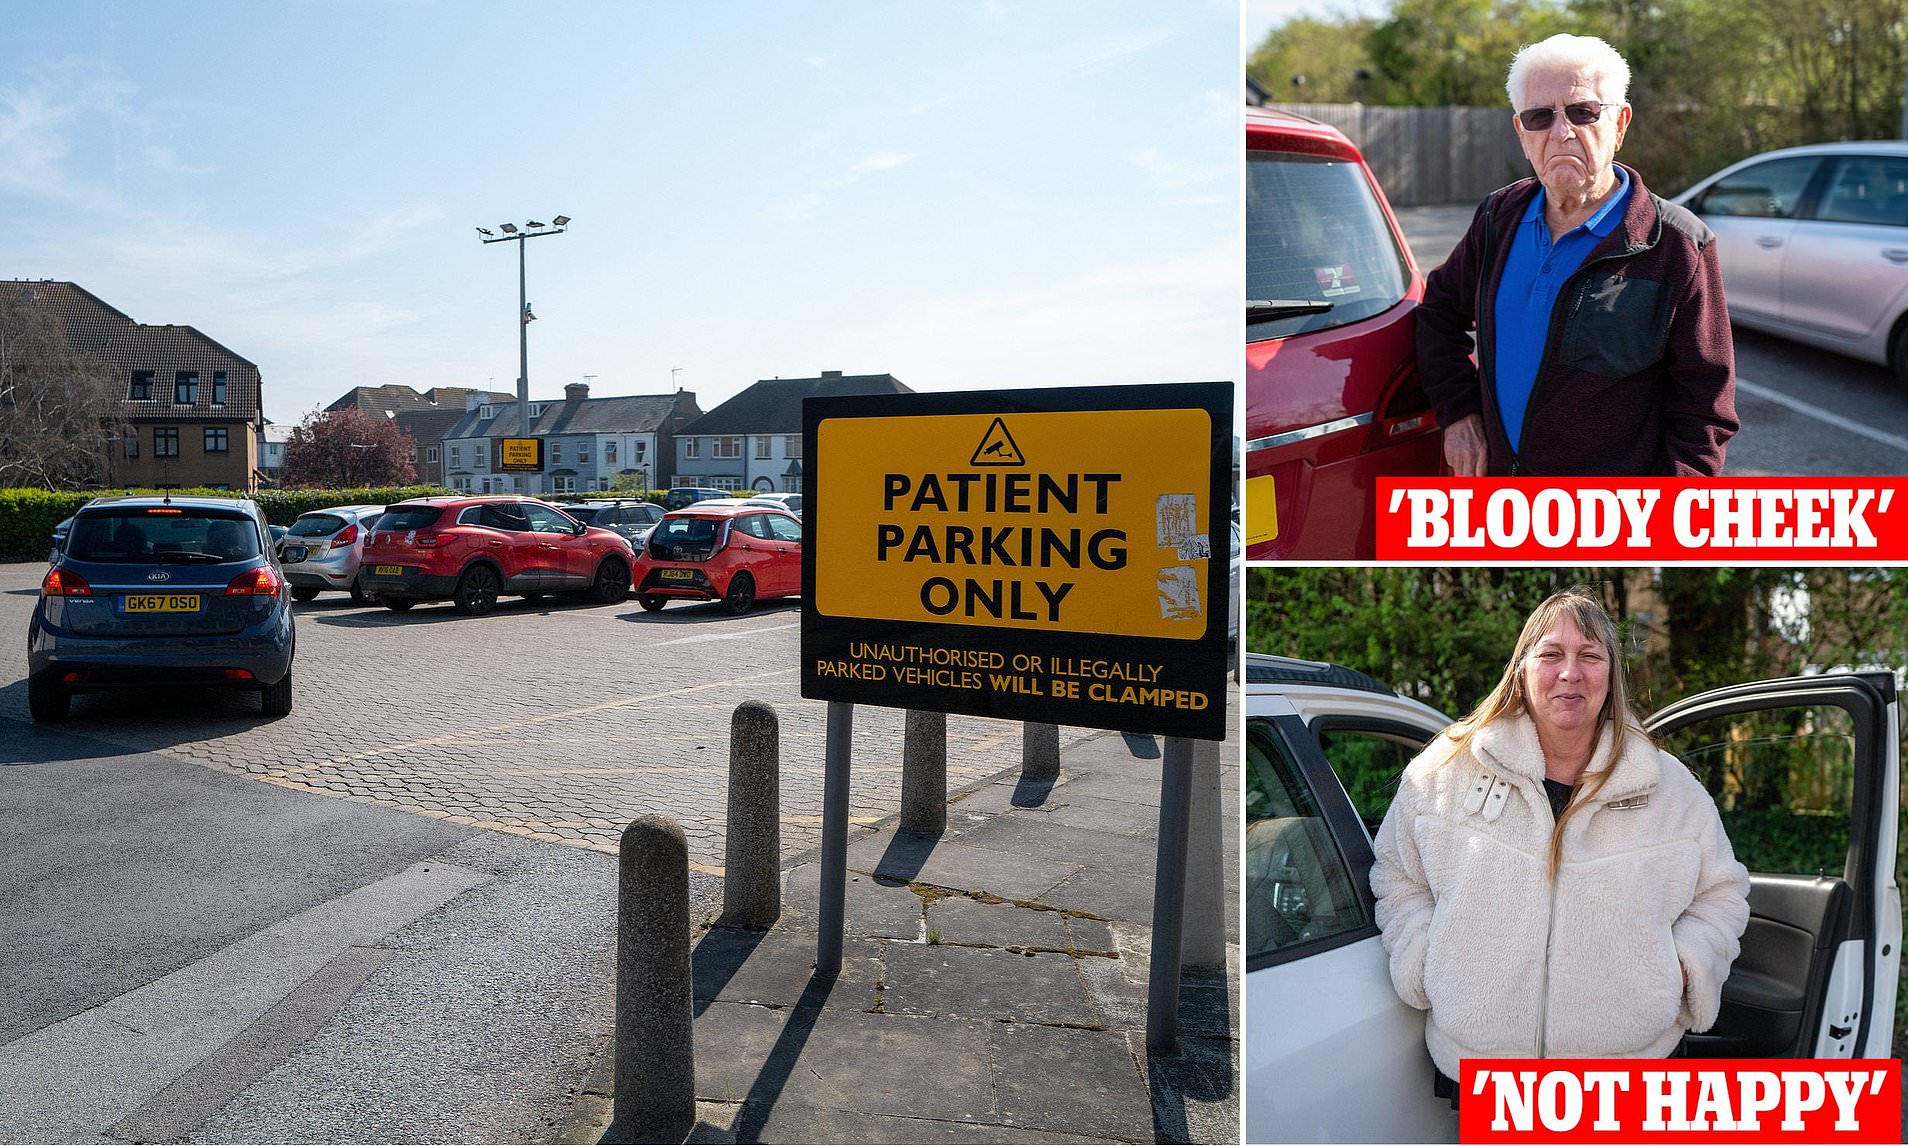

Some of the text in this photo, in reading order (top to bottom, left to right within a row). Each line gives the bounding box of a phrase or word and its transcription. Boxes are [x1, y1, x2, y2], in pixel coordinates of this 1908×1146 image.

[883, 473, 1122, 515] PATIENT
[877, 524, 1128, 570] PARKING
[127, 596, 166, 609] GK67
[920, 576, 1075, 621] ONLY
[850, 642, 1164, 682] UNAUTHORISED OR ILLEGALLY
[817, 660, 1209, 710] PARKED VEHICLES WILL BE CLAMPED
